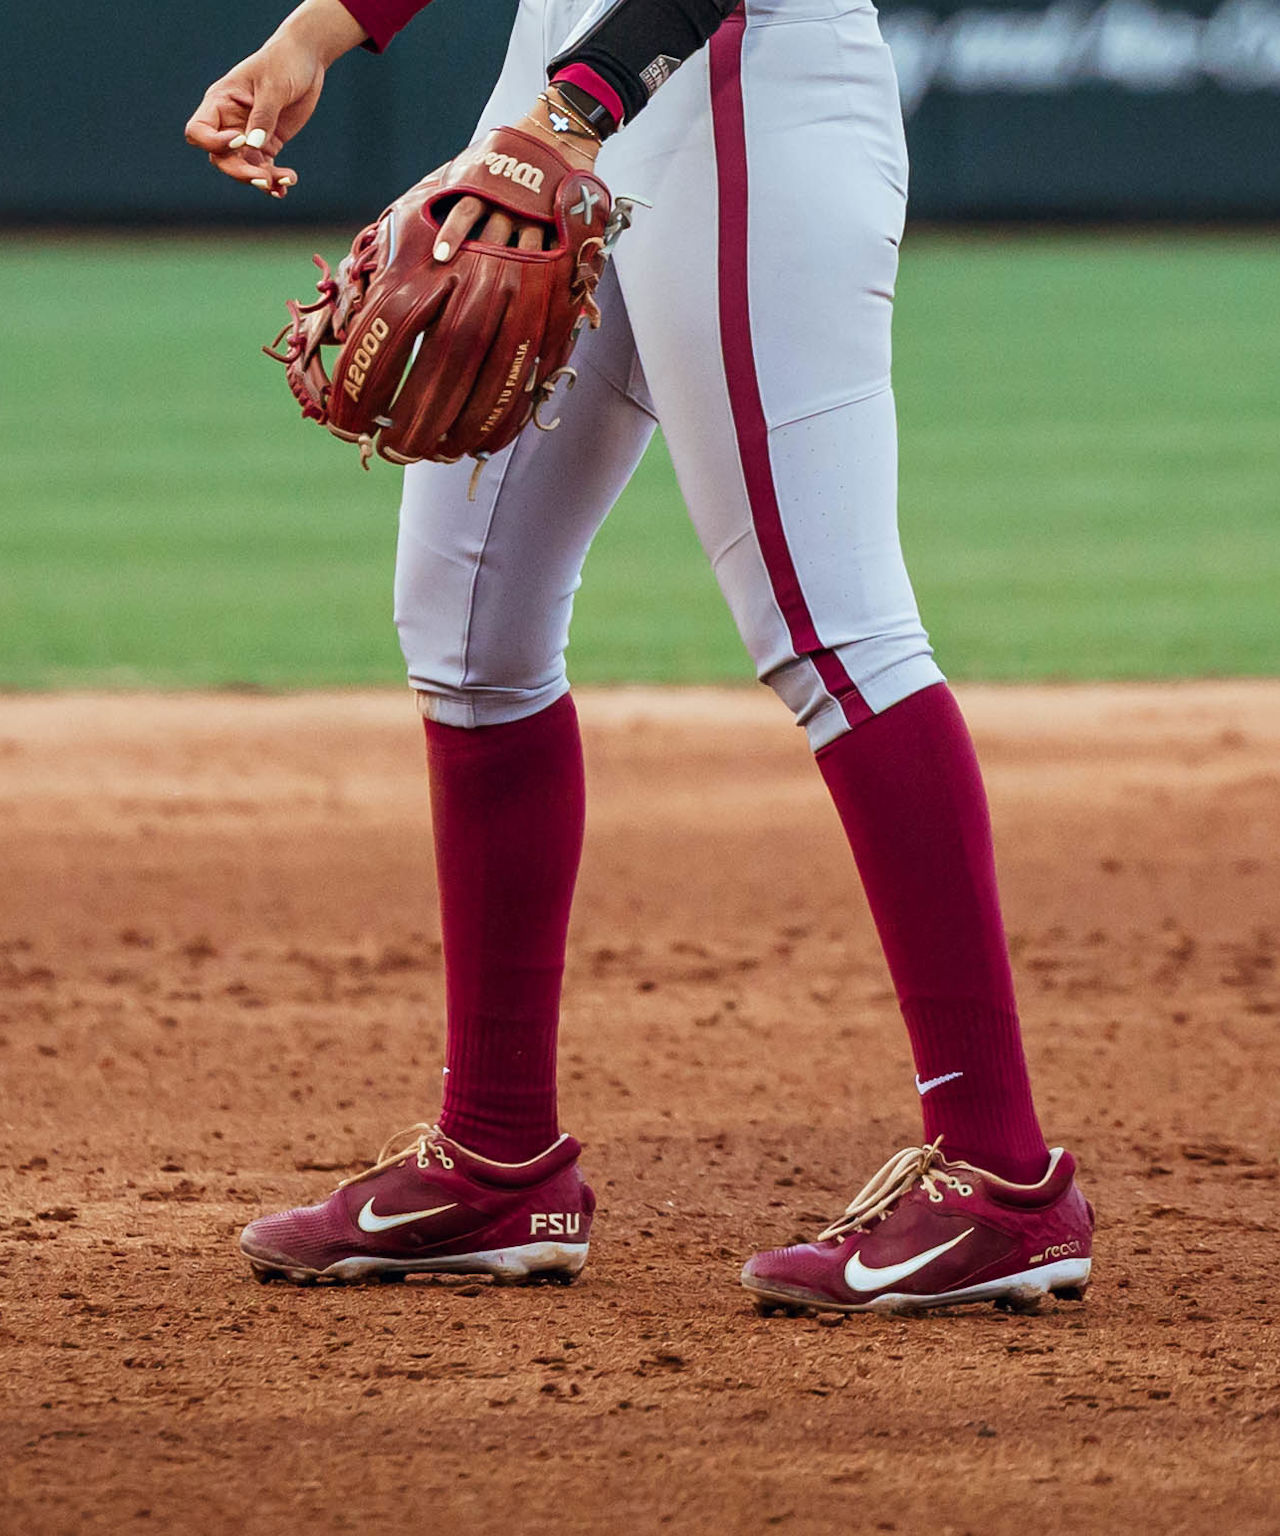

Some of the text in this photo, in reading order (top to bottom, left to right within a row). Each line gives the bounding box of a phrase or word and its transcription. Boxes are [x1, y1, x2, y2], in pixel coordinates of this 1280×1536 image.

[470, 151, 545, 194] Wilso
[343, 317, 389, 402] A2000
[529, 1212, 580, 1236] FSU
